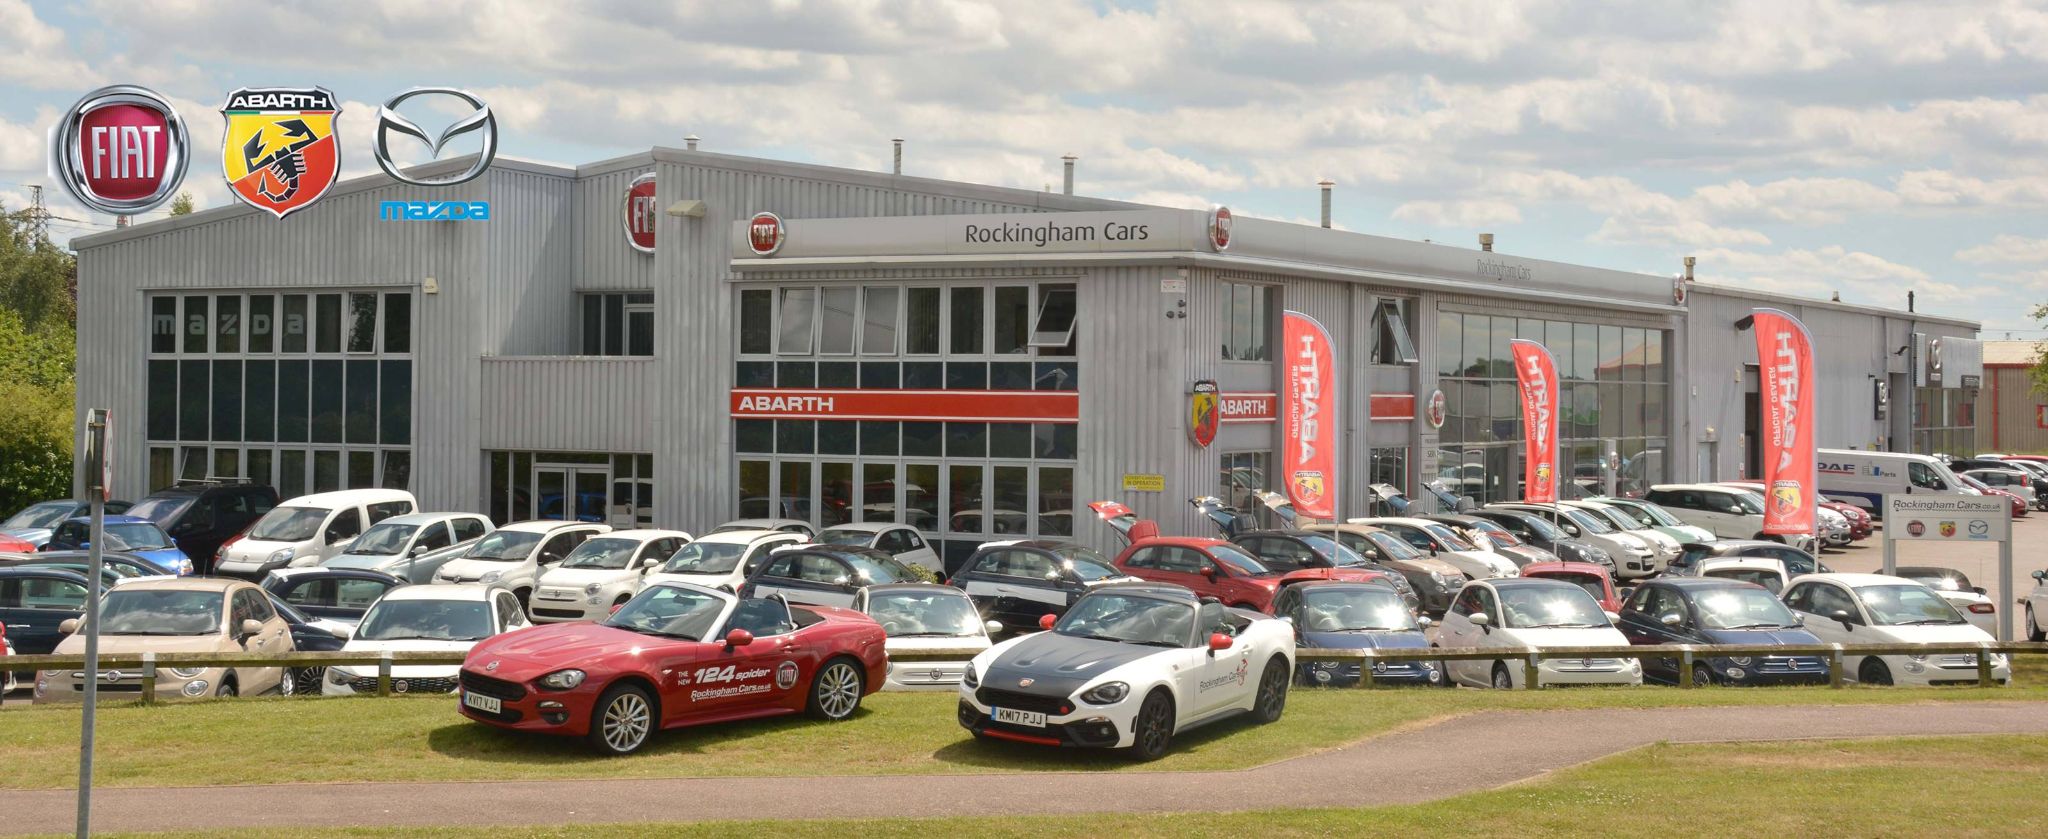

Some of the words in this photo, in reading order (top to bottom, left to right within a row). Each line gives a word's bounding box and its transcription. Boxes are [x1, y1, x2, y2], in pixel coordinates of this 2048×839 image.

[965, 221, 1095, 247] Rockingham
[1103, 222, 1149, 241] Cars
[153, 313, 304, 335] mazda
[1195, 383, 1216, 392] ABARTH
[739, 396, 834, 412] ABARTH
[1220, 399, 1267, 415] ABARTH
[1817, 462, 1855, 471] DAF
[1893, 500, 1954, 510] Rockingham
[693, 665, 736, 684] 124
[735, 668, 771, 681] spider
[781, 669, 794, 682] FIAT
[691, 687, 738, 699] Rockingham
[468, 693, 483, 708] KV17
[484, 697, 498, 711] VJJ
[1000, 709, 1020, 722] KM17
[1023, 712, 1042, 725] PJJ
